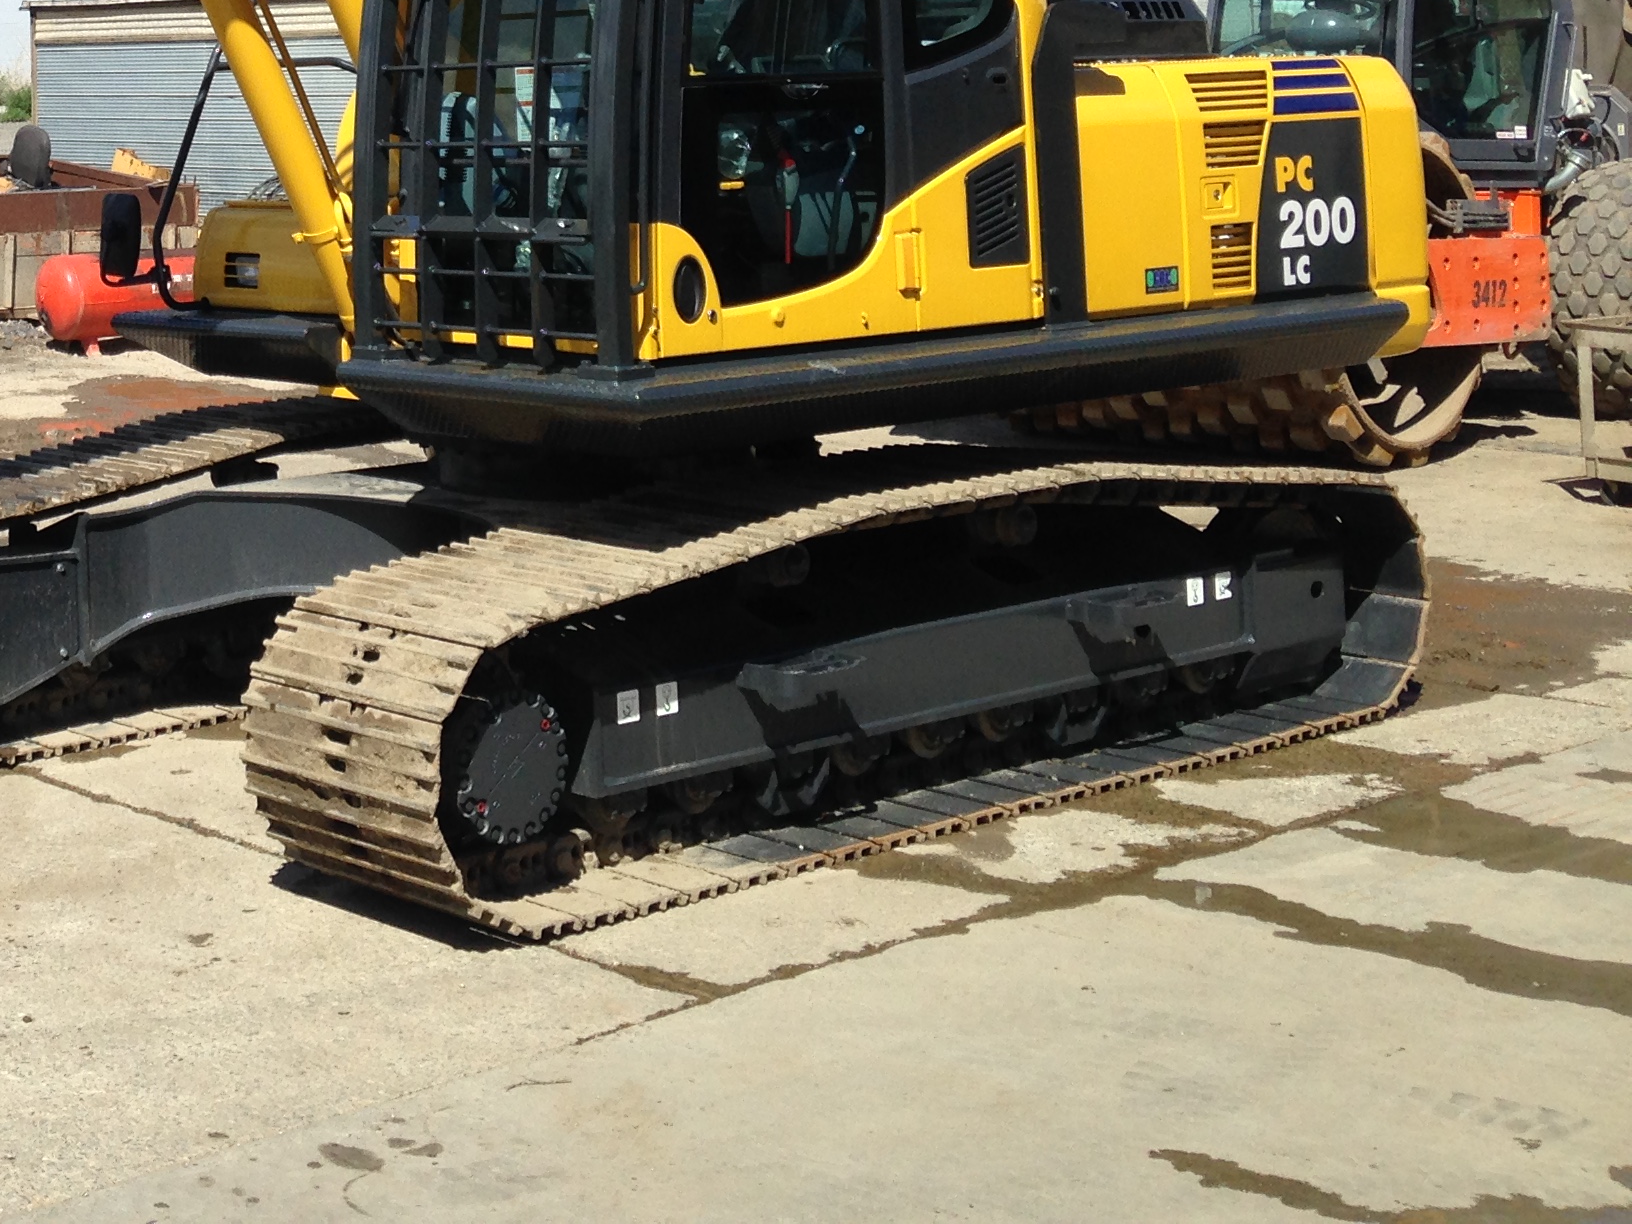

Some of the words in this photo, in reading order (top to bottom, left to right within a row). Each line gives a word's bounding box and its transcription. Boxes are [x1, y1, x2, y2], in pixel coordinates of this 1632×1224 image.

[1275, 155, 1314, 193] PC
[1279, 196, 1356, 249] 200
[1282, 255, 1311, 286] LC
[1471, 279, 1507, 308] 3412
